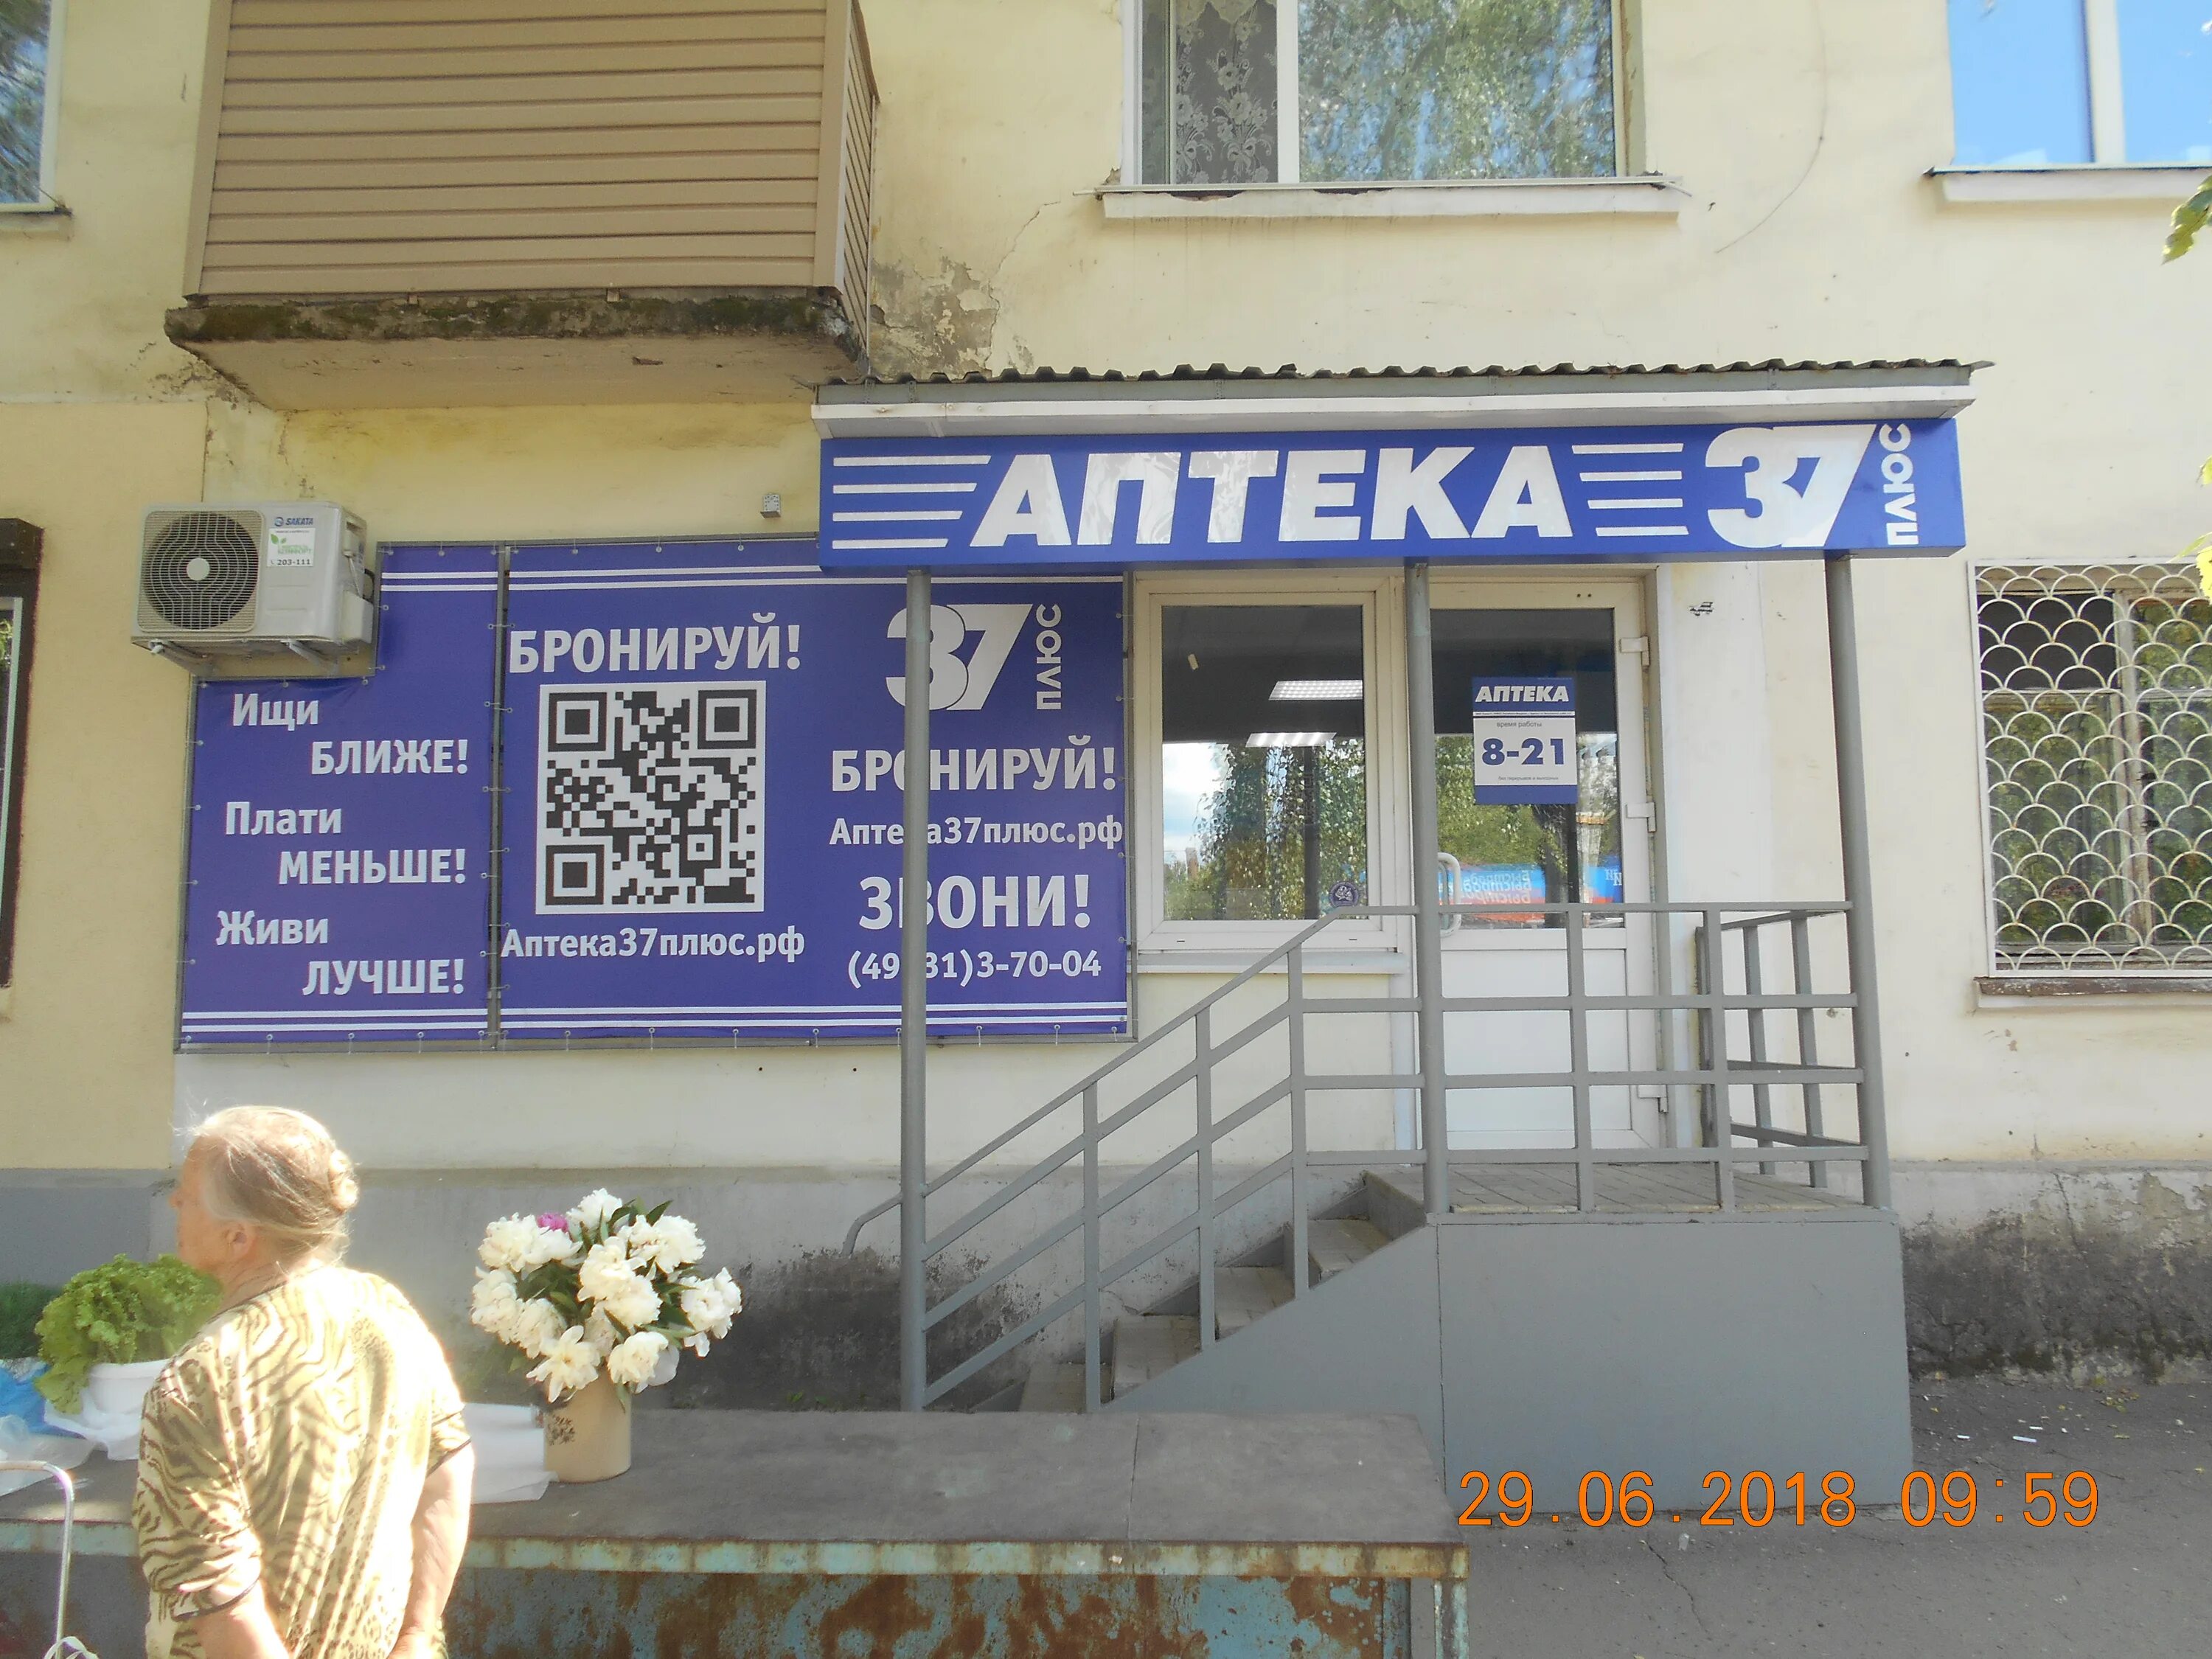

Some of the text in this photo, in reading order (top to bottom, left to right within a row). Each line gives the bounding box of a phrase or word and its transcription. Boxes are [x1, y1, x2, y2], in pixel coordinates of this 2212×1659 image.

[969, 445, 1573, 546] АПТЕКА
[1705, 424, 1877, 549] 37
[1878, 422, 1919, 546] ПЛЮС
[509, 612, 801, 673] БРОНИРУЙ!
[1035, 603, 1062, 710] ПЛЮС
[232, 692, 319, 731] Ищи
[1475, 686, 1569, 702] АПТЕКА
[310, 740, 469, 775] БЛИЖЕ!
[1482, 738, 1564, 765] 8-21
[225, 801, 341, 835] Плати
[830, 815, 1124, 850] Аптеа37плюс.рф
[278, 849, 466, 885] МЕНЬШЕ!
[216, 911, 328, 946] Живи
[501, 925, 805, 963] Аптека37плюс.рф
[302, 959, 465, 995] ЛУЧШЕ!
[848, 949, 1102, 989] (4931)3-70-04
